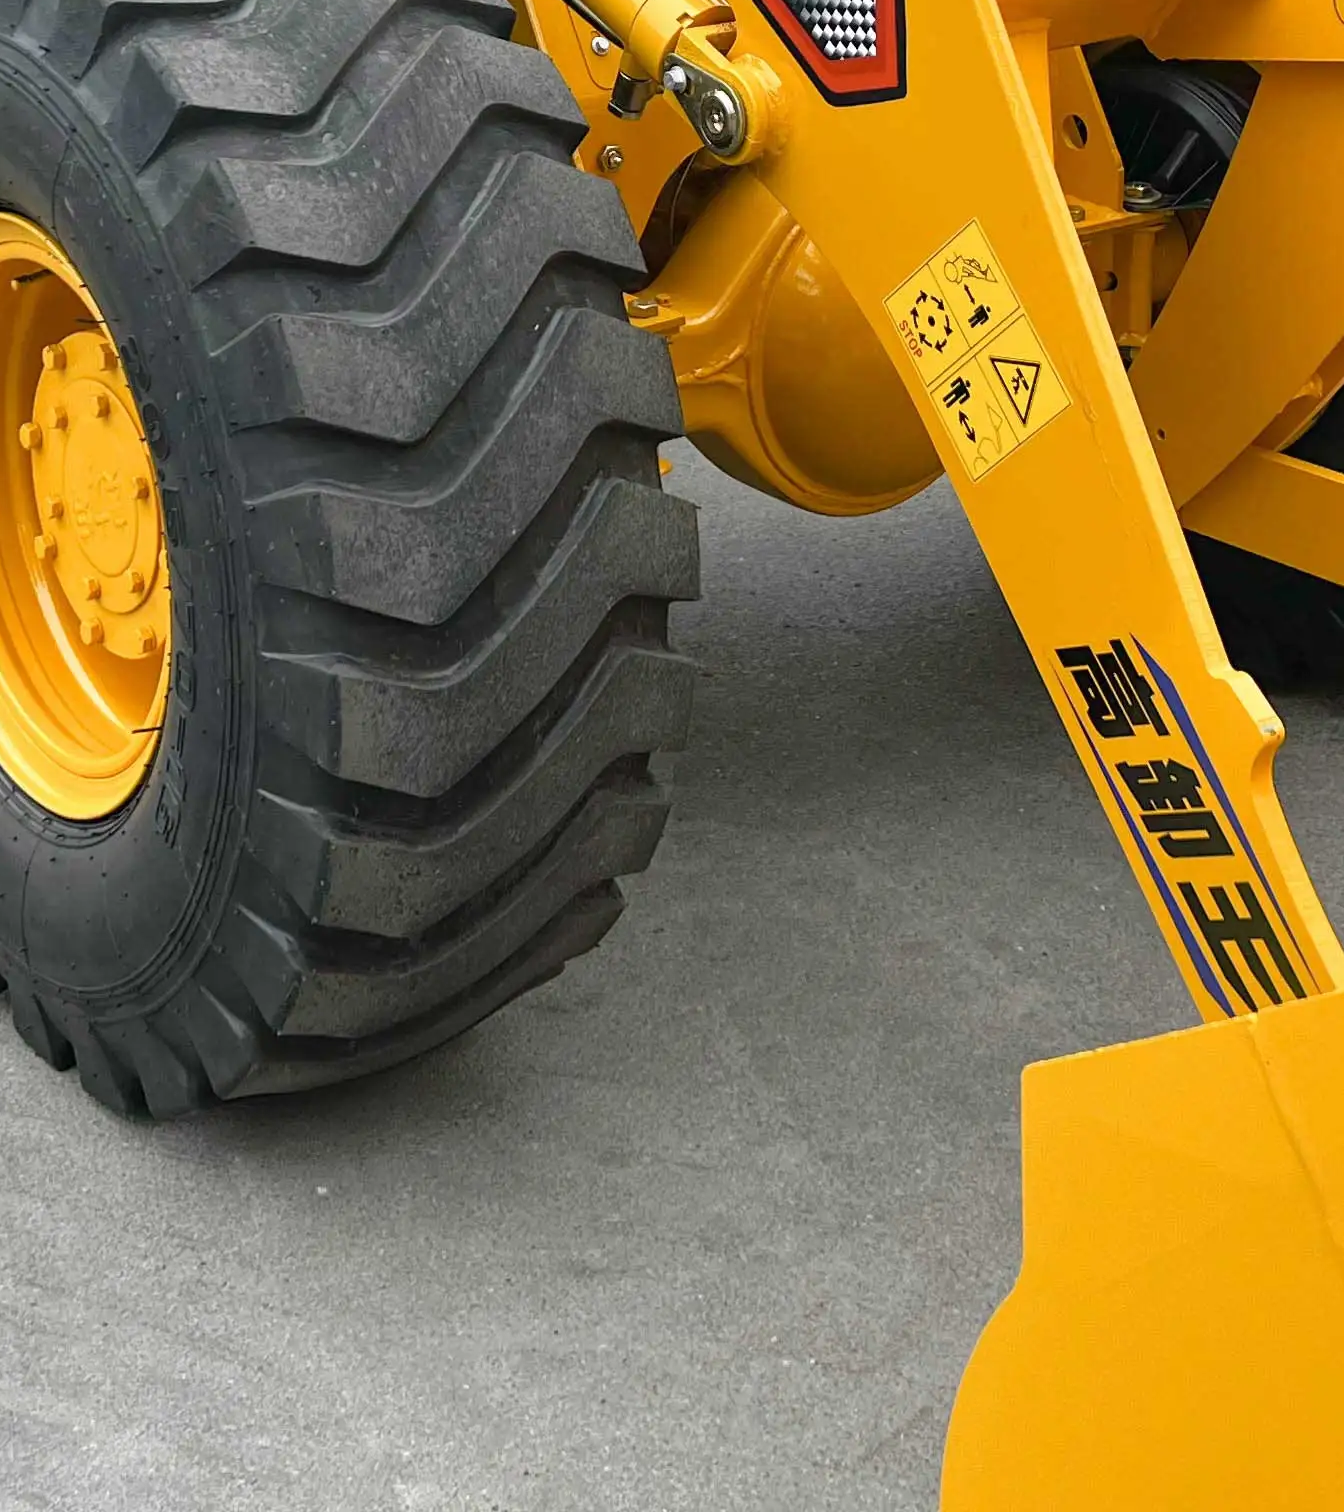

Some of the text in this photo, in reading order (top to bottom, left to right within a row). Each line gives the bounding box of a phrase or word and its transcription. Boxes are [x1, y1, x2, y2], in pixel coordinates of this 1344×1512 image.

[899, 319, 924, 359] STOP
[1054, 638, 1307, 1013] 高卸王
